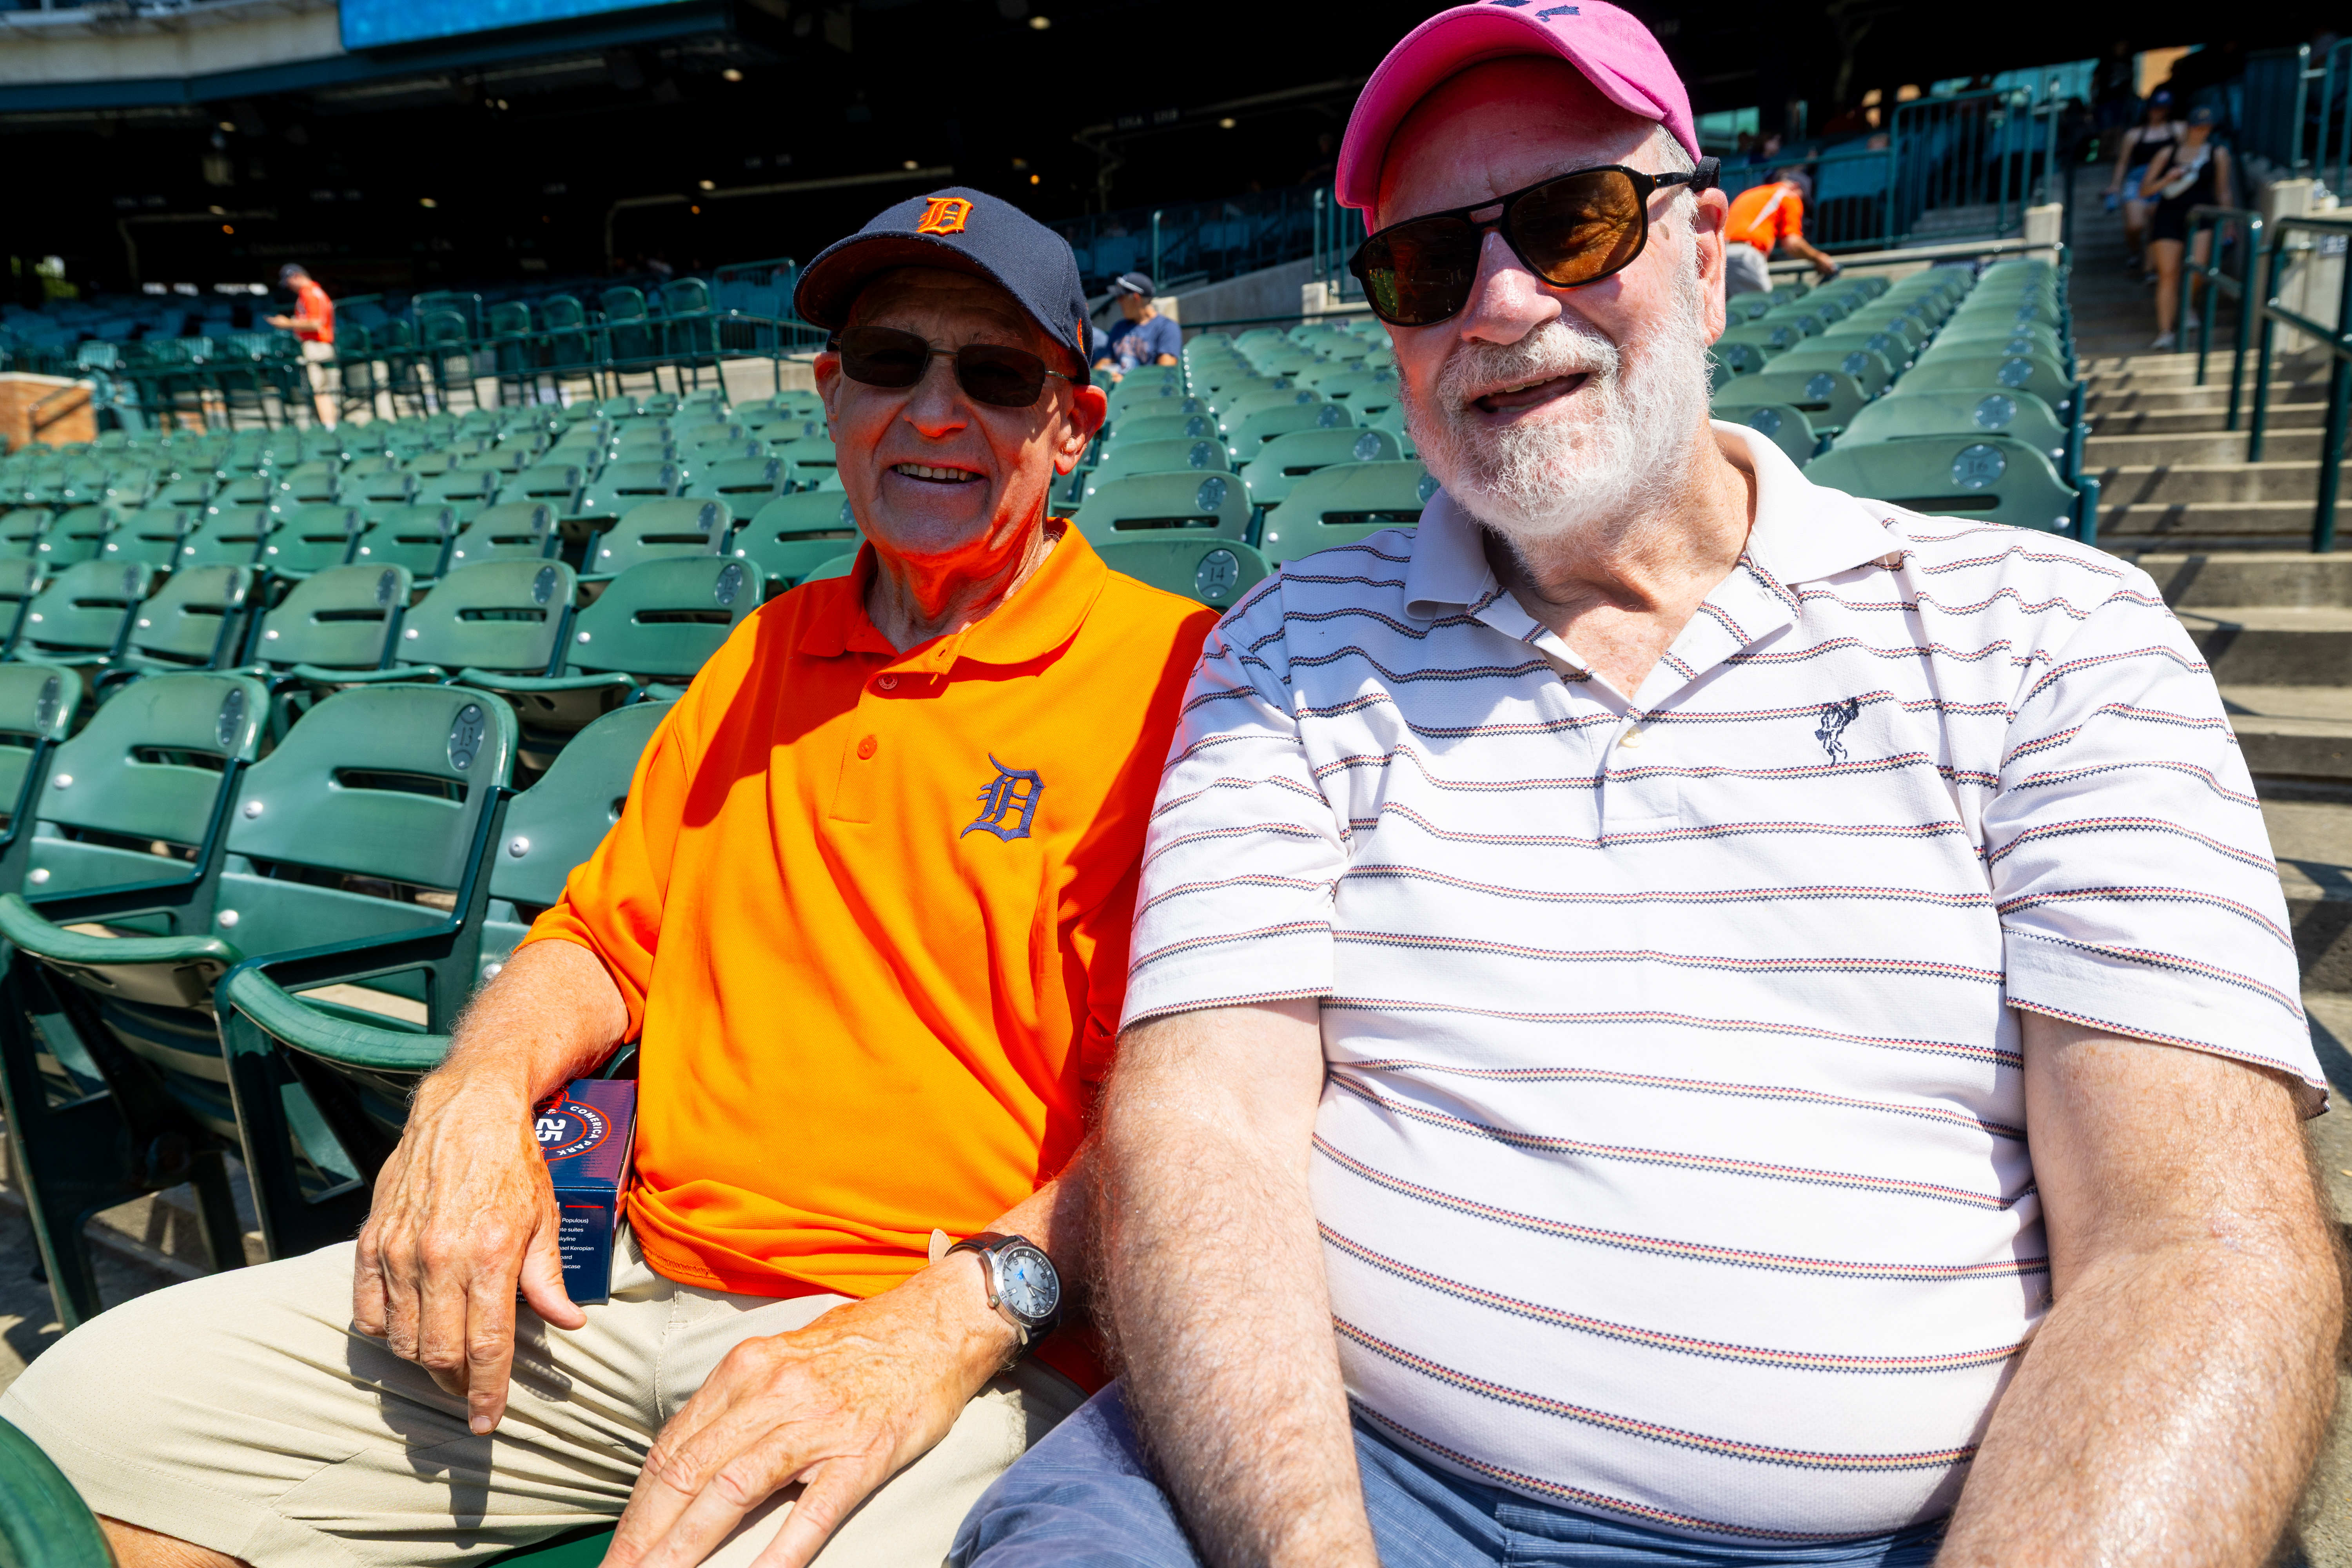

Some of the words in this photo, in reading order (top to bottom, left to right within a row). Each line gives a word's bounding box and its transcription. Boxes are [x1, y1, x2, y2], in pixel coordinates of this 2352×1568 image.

[916, 197, 974, 237] D
[1210, 567, 1225, 582] 14
[459, 726, 474, 746] 13
[960, 753, 1045, 843] D
[535, 1118, 566, 1142] 25
[570, 1106, 602, 1138] COMERICA
[556, 1140, 593, 1156] PARK
